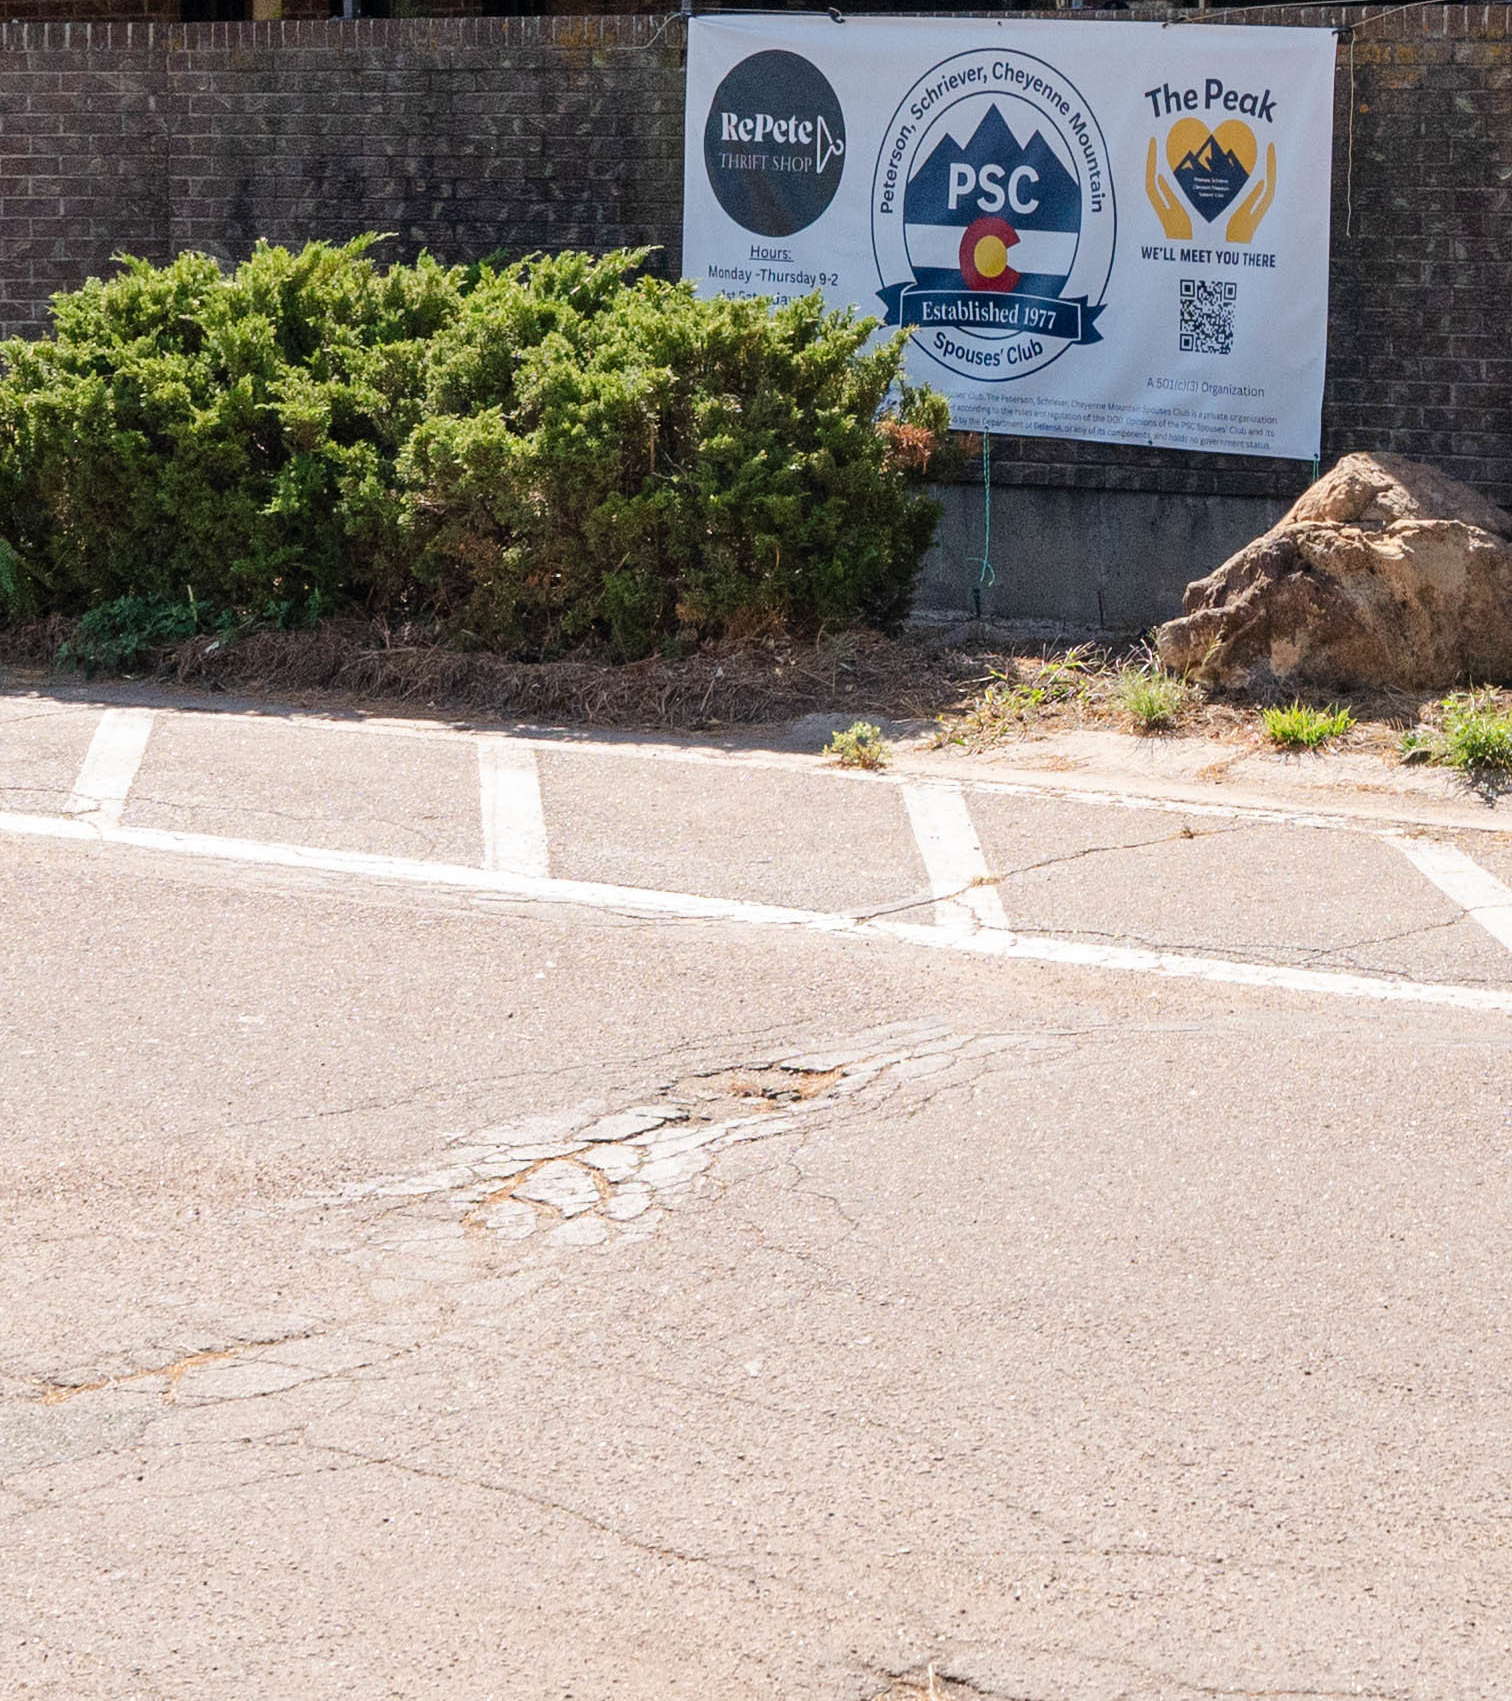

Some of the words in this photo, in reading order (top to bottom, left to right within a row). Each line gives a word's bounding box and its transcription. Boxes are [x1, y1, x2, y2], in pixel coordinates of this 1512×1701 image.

[1144, 83, 1198, 118] The
[1204, 78, 1278, 123] Peak
[720, 112, 814, 145] RePete
[881, 121, 917, 214] Peterson,
[911, 66, 987, 120] Schriever,
[992, 62, 1070, 115] Cheyenne
[1069, 113, 1106, 213] Mountain
[719, 152, 769, 170] THRIFT
[773, 156, 813, 173] SHOP
[948, 162, 1040, 215] PSC
[750, 245, 793, 261] Hours:
[1141, 246, 1176, 261] WE'LL
[1180, 248, 1212, 264] MEET
[1216, 250, 1240, 266] YOU
[1243, 252, 1276, 268] THERE
[708, 265, 752, 284] Monday
[819, 272, 839, 286] 9-2
[922, 301, 1020, 324] Established
[1023, 306, 1057, 330] 1977
[934, 332, 1004, 367] Spouses'
[1007, 339, 1044, 365] Club
[1147, 378, 1154, 388] A
[1156, 378, 1199, 393] 501(c)(3)
[1201, 381, 1265, 398] Organization
